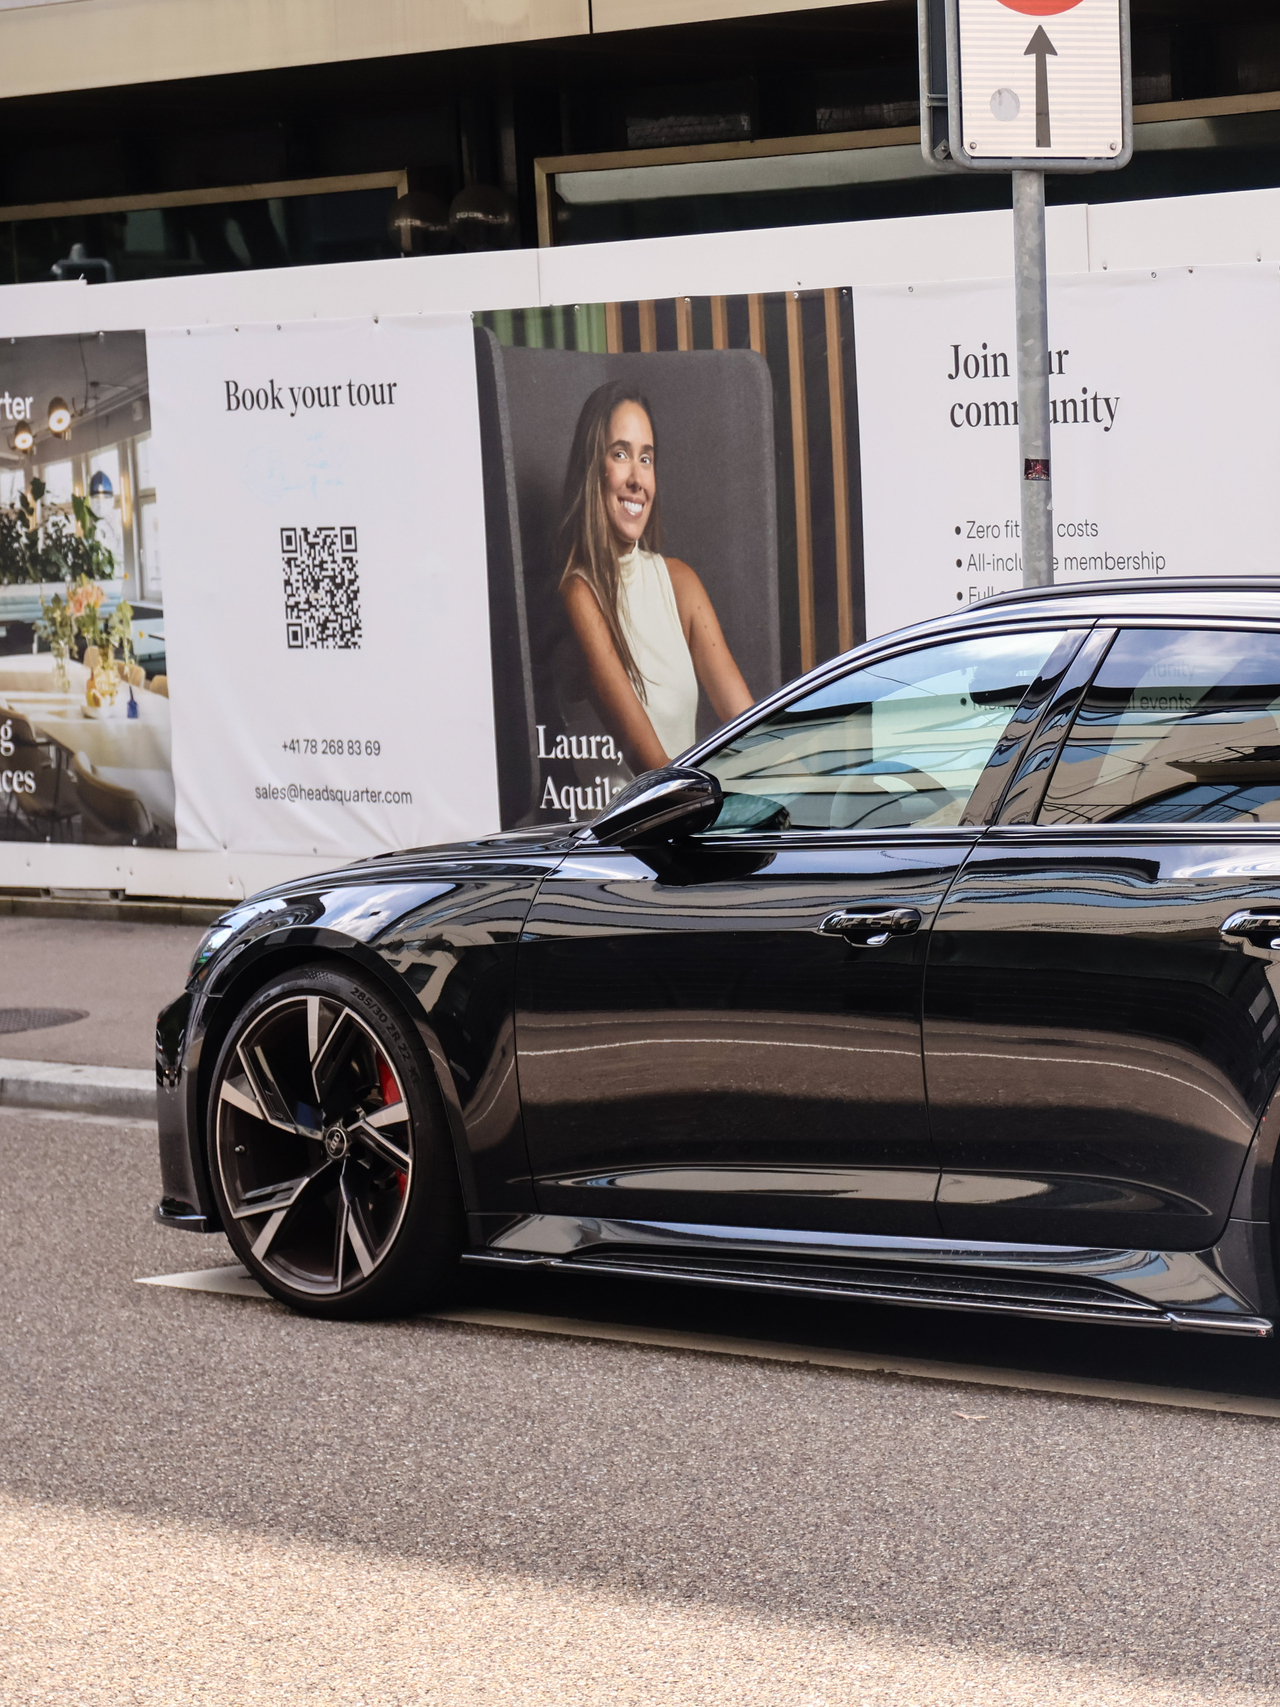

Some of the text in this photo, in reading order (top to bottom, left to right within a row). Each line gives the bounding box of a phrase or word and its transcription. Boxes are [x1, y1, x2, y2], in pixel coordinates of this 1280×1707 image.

[947, 342, 1011, 380] Join
[0, 390, 34, 421] ter
[223, 378, 398, 418] Book your tour
[966, 520, 1001, 539] Zero
[1056, 518, 1099, 538] costs
[1063, 551, 1166, 575] membership
[1139, 693, 1193, 711] events
[281, 738, 381, 757] +41 78 268 83 69
[535, 724, 624, 767] Laura,
[0, 769, 37, 794] ces
[254, 782, 413, 807] sales@headsquarter.com
[539, 775, 622, 823] Aquil
[350, 986, 388, 1024] 285/30
[386, 1023, 401, 1042] ZR
[397, 1043, 412, 1062] 22
